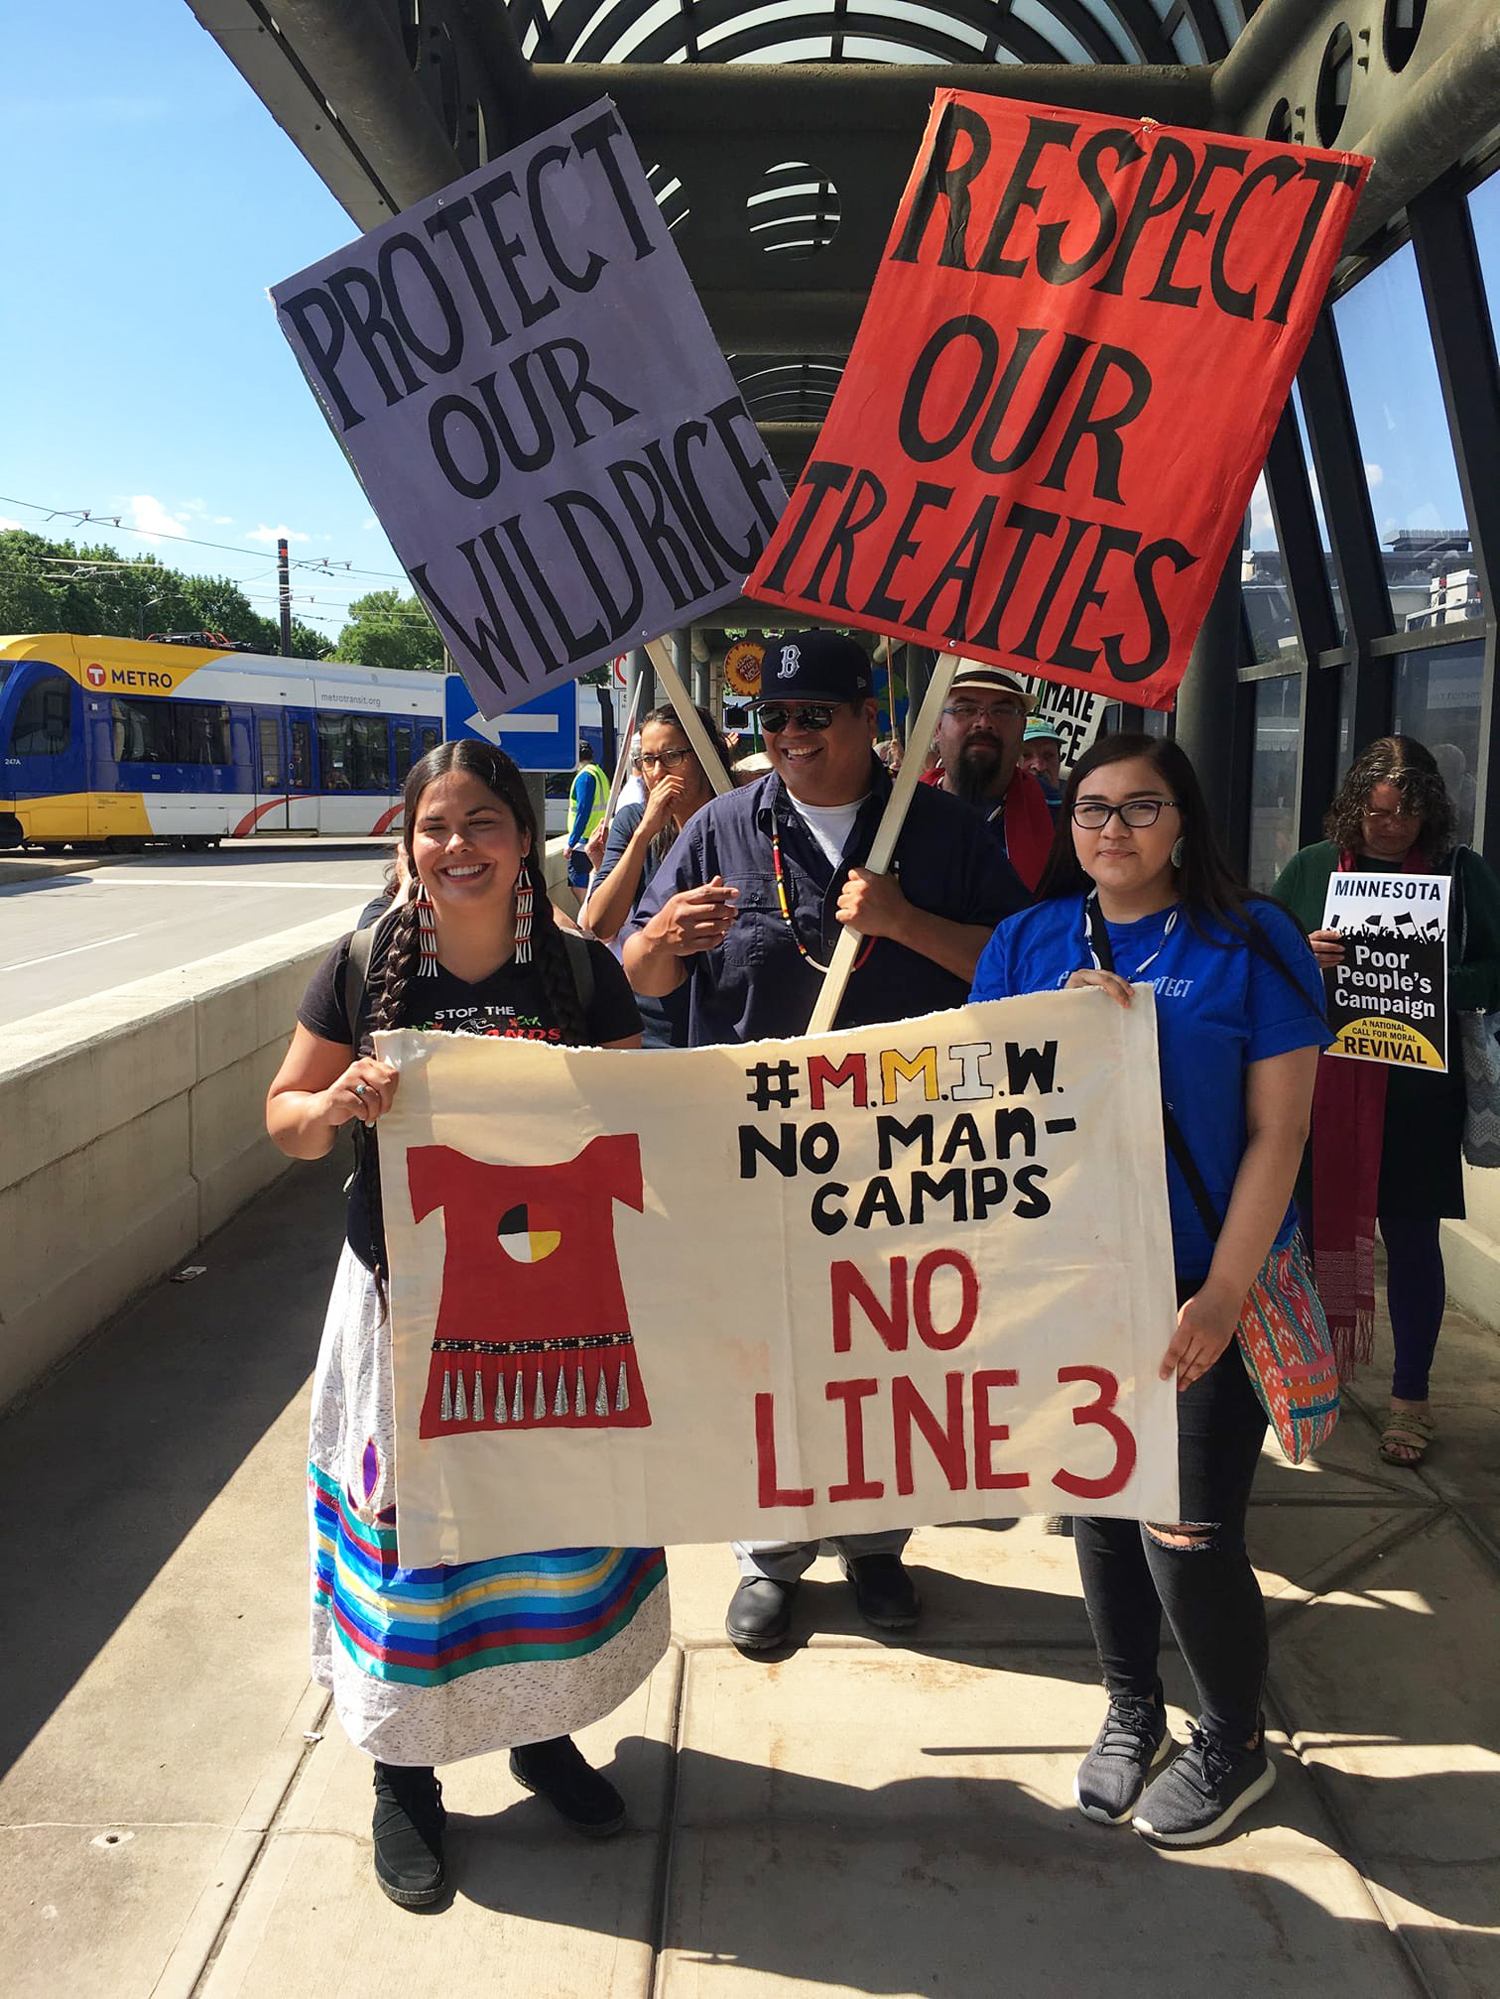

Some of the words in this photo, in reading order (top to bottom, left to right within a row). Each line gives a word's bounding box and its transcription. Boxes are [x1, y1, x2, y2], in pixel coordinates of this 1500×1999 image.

[889, 102, 1357, 326] RESPECT
[281, 108, 656, 433] PROTECT
[427, 338, 640, 499] OUR
[899, 314, 1153, 506] OUR
[409, 490, 644, 696] WILD
[605, 394, 784, 611] RICE
[761, 461, 1199, 683] TREATIES
[111, 668, 173, 688] METRO
[777, 644, 801, 678] B
[320, 693, 381, 708] metrotransit.org
[1335, 880, 1441, 900] MINNESOTA
[1336, 964, 1432, 994] People's
[1354, 945, 1410, 970] Poor
[434, 1007, 478, 1020] STOP
[484, 1006, 516, 1016] THE
[1334, 988, 1435, 1020] Campaign
[1369, 1020, 1406, 1032] NATIONAL
[1344, 1036, 1428, 1065] REVIVAL
[1352, 1028, 1371, 1037] CALL
[1372, 1030, 1388, 1039] FOR
[1390, 1032, 1418, 1043] MORAL
[745, 1040, 1065, 1111] #M.M.I.W.
[738, 1120, 840, 1179] NO
[811, 1163, 1052, 1236] CAMPS
[830, 1247, 982, 1353] NO
[754, 1369, 1030, 1509] LINE
[1051, 1364, 1138, 1499] 3
